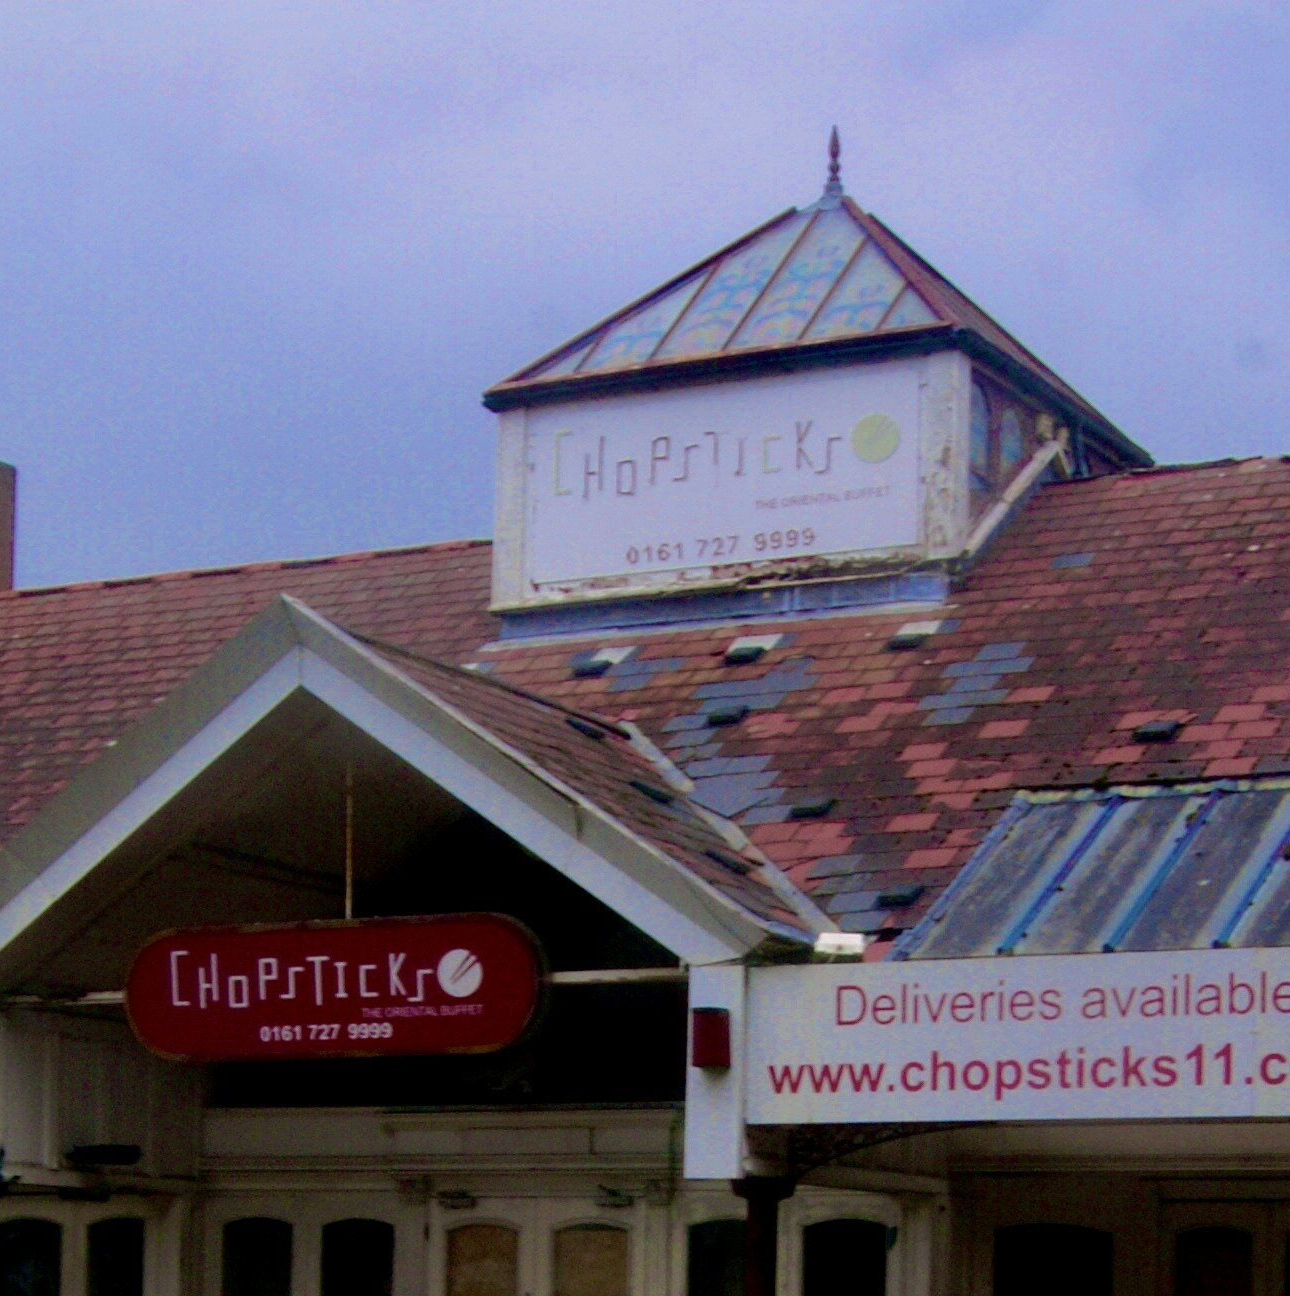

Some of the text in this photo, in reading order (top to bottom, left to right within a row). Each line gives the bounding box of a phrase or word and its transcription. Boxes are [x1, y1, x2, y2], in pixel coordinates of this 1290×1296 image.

[625, 526, 817, 566] 0161 727 9999
[833, 976, 1063, 1029] Deliveries
[259, 1021, 394, 1043] 0161 727 9999
